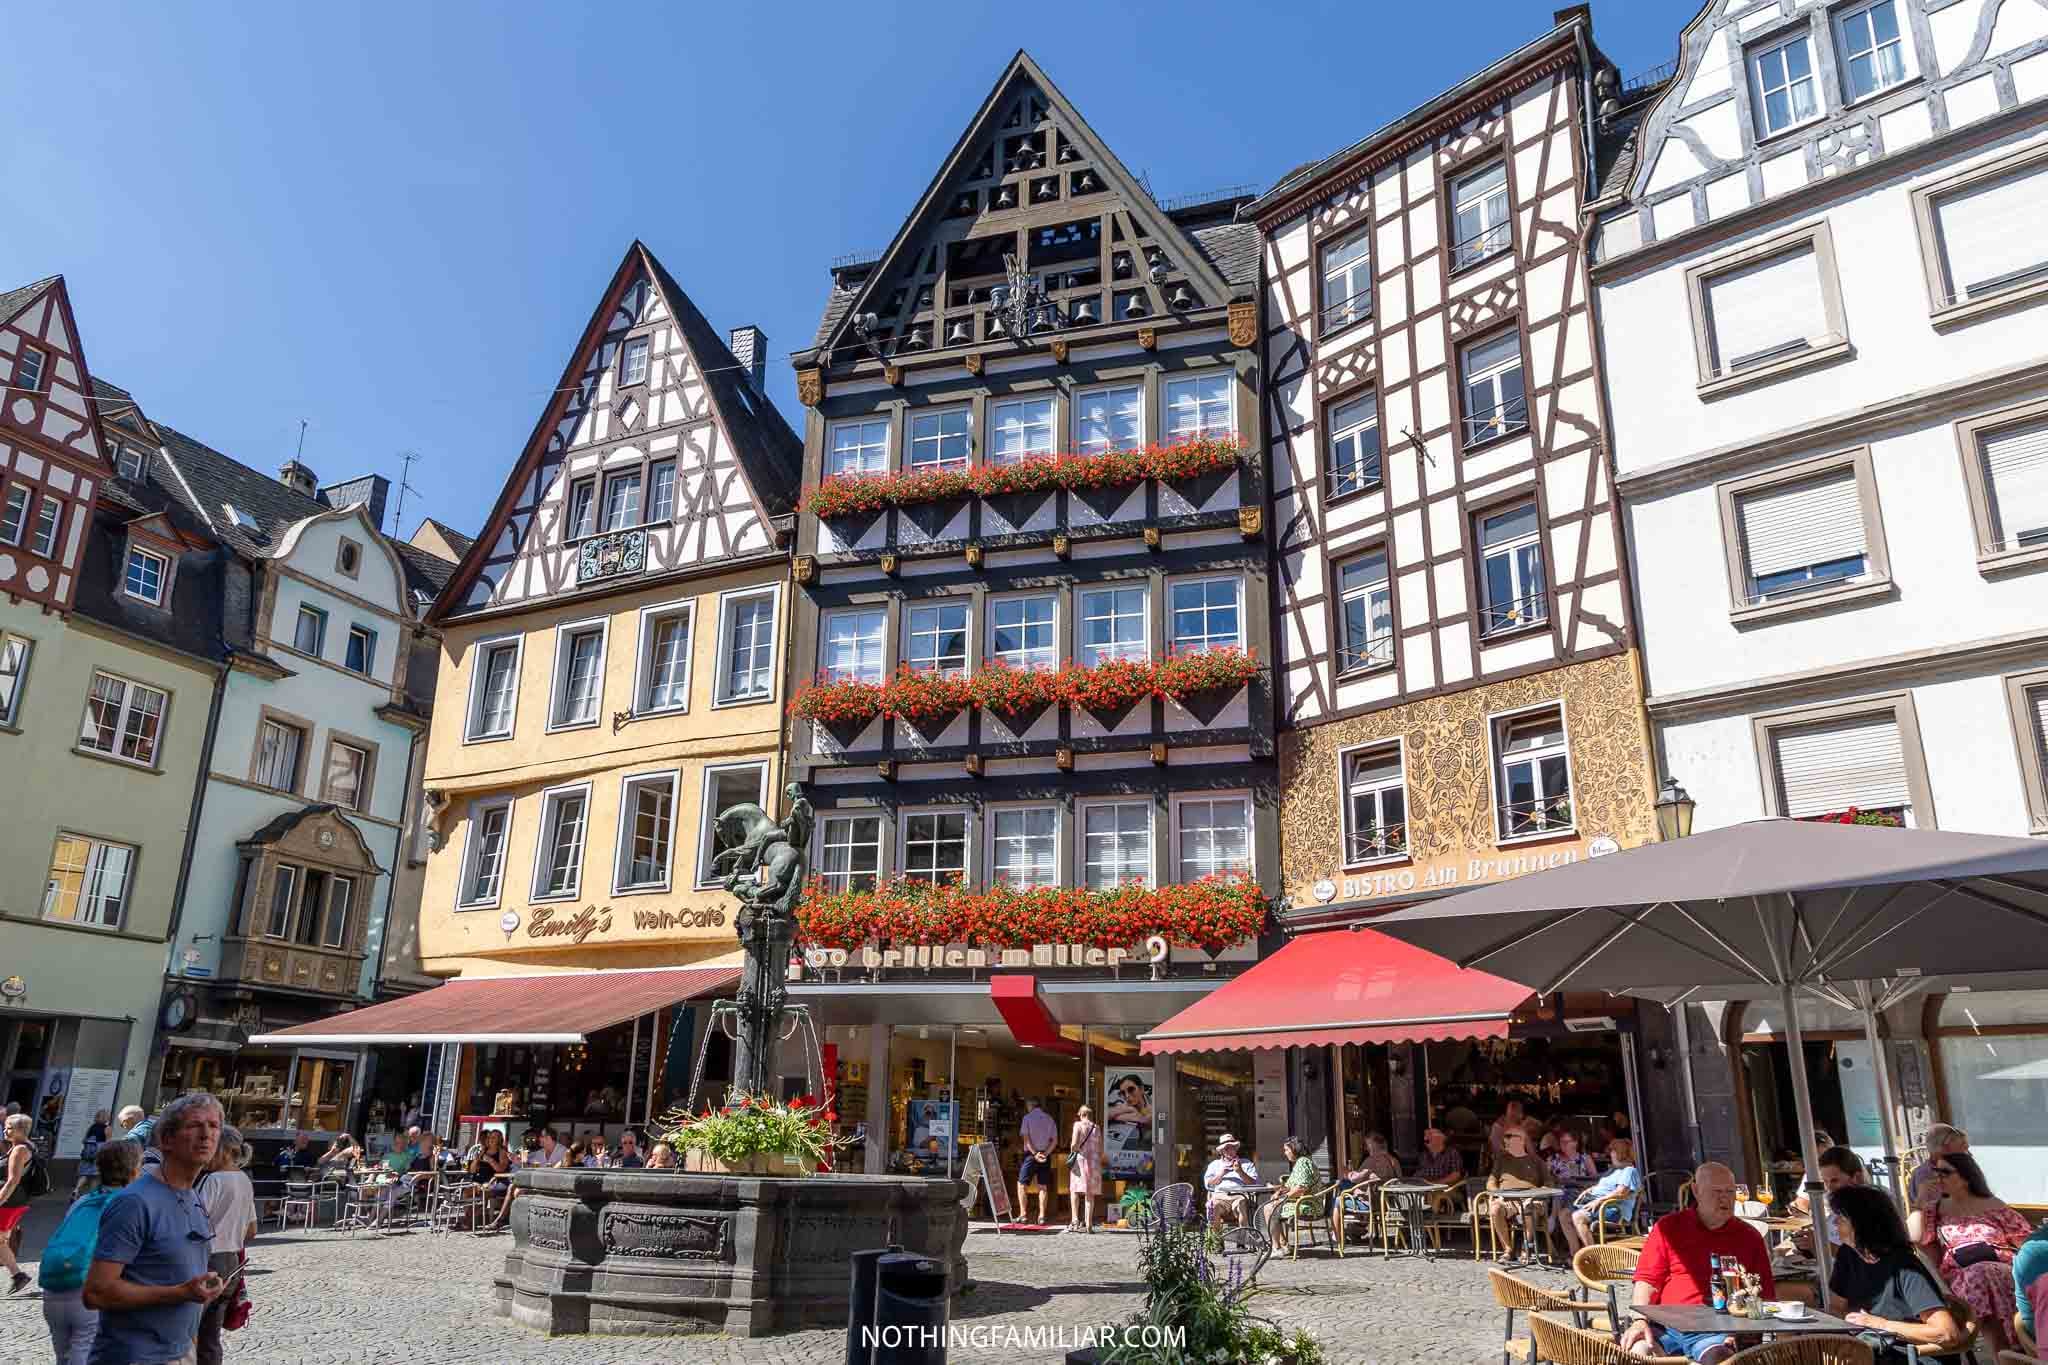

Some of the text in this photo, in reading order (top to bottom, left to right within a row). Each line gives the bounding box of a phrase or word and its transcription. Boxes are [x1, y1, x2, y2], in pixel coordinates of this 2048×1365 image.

[1342, 870, 1416, 898] BISTRO
[1423, 863, 1457, 887] Am
[1467, 848, 1578, 881] Brunnen
[527, 903, 727, 944] Emily's Wein-Café
[862, 943, 1128, 968] brillen müller
